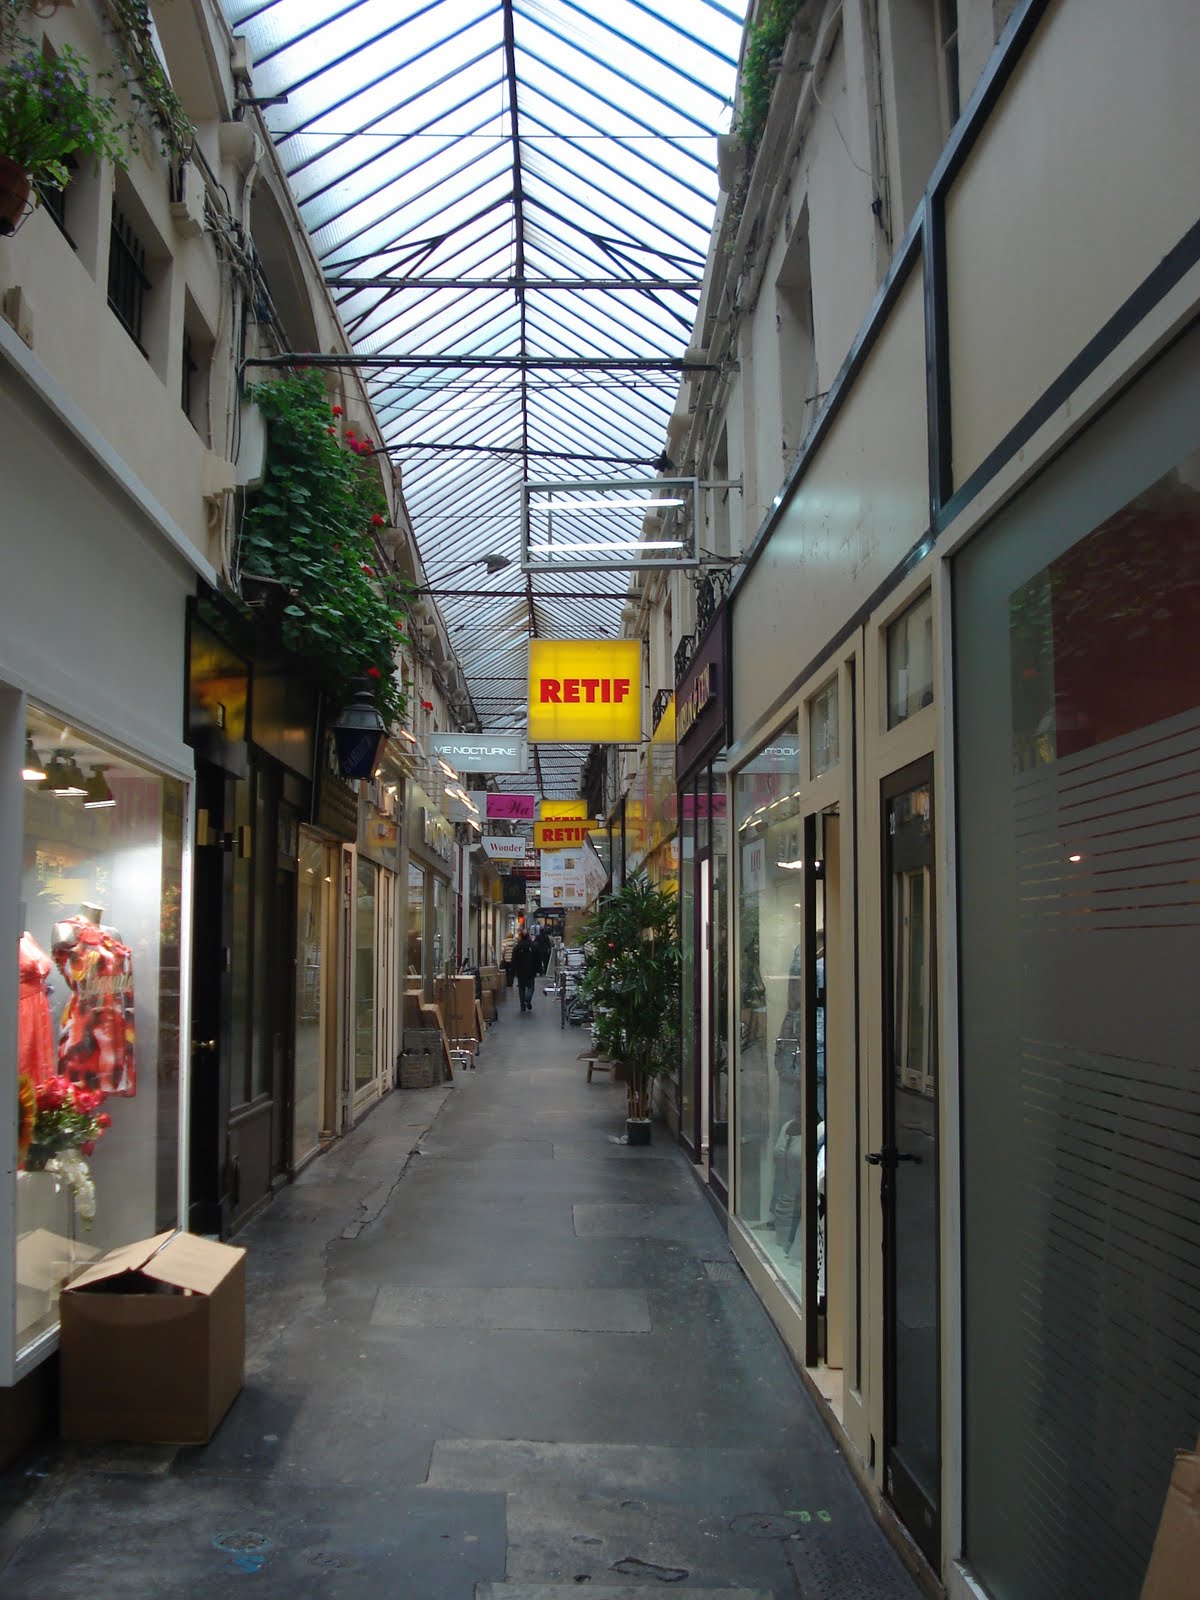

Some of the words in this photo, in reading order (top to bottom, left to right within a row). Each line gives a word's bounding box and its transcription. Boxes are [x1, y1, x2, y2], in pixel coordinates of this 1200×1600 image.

[540, 679, 630, 703] RETIF
[434, 746, 452, 754] VIE
[453, 746, 517, 756] NOCTURNE
[490, 842, 522, 852] Wonder
